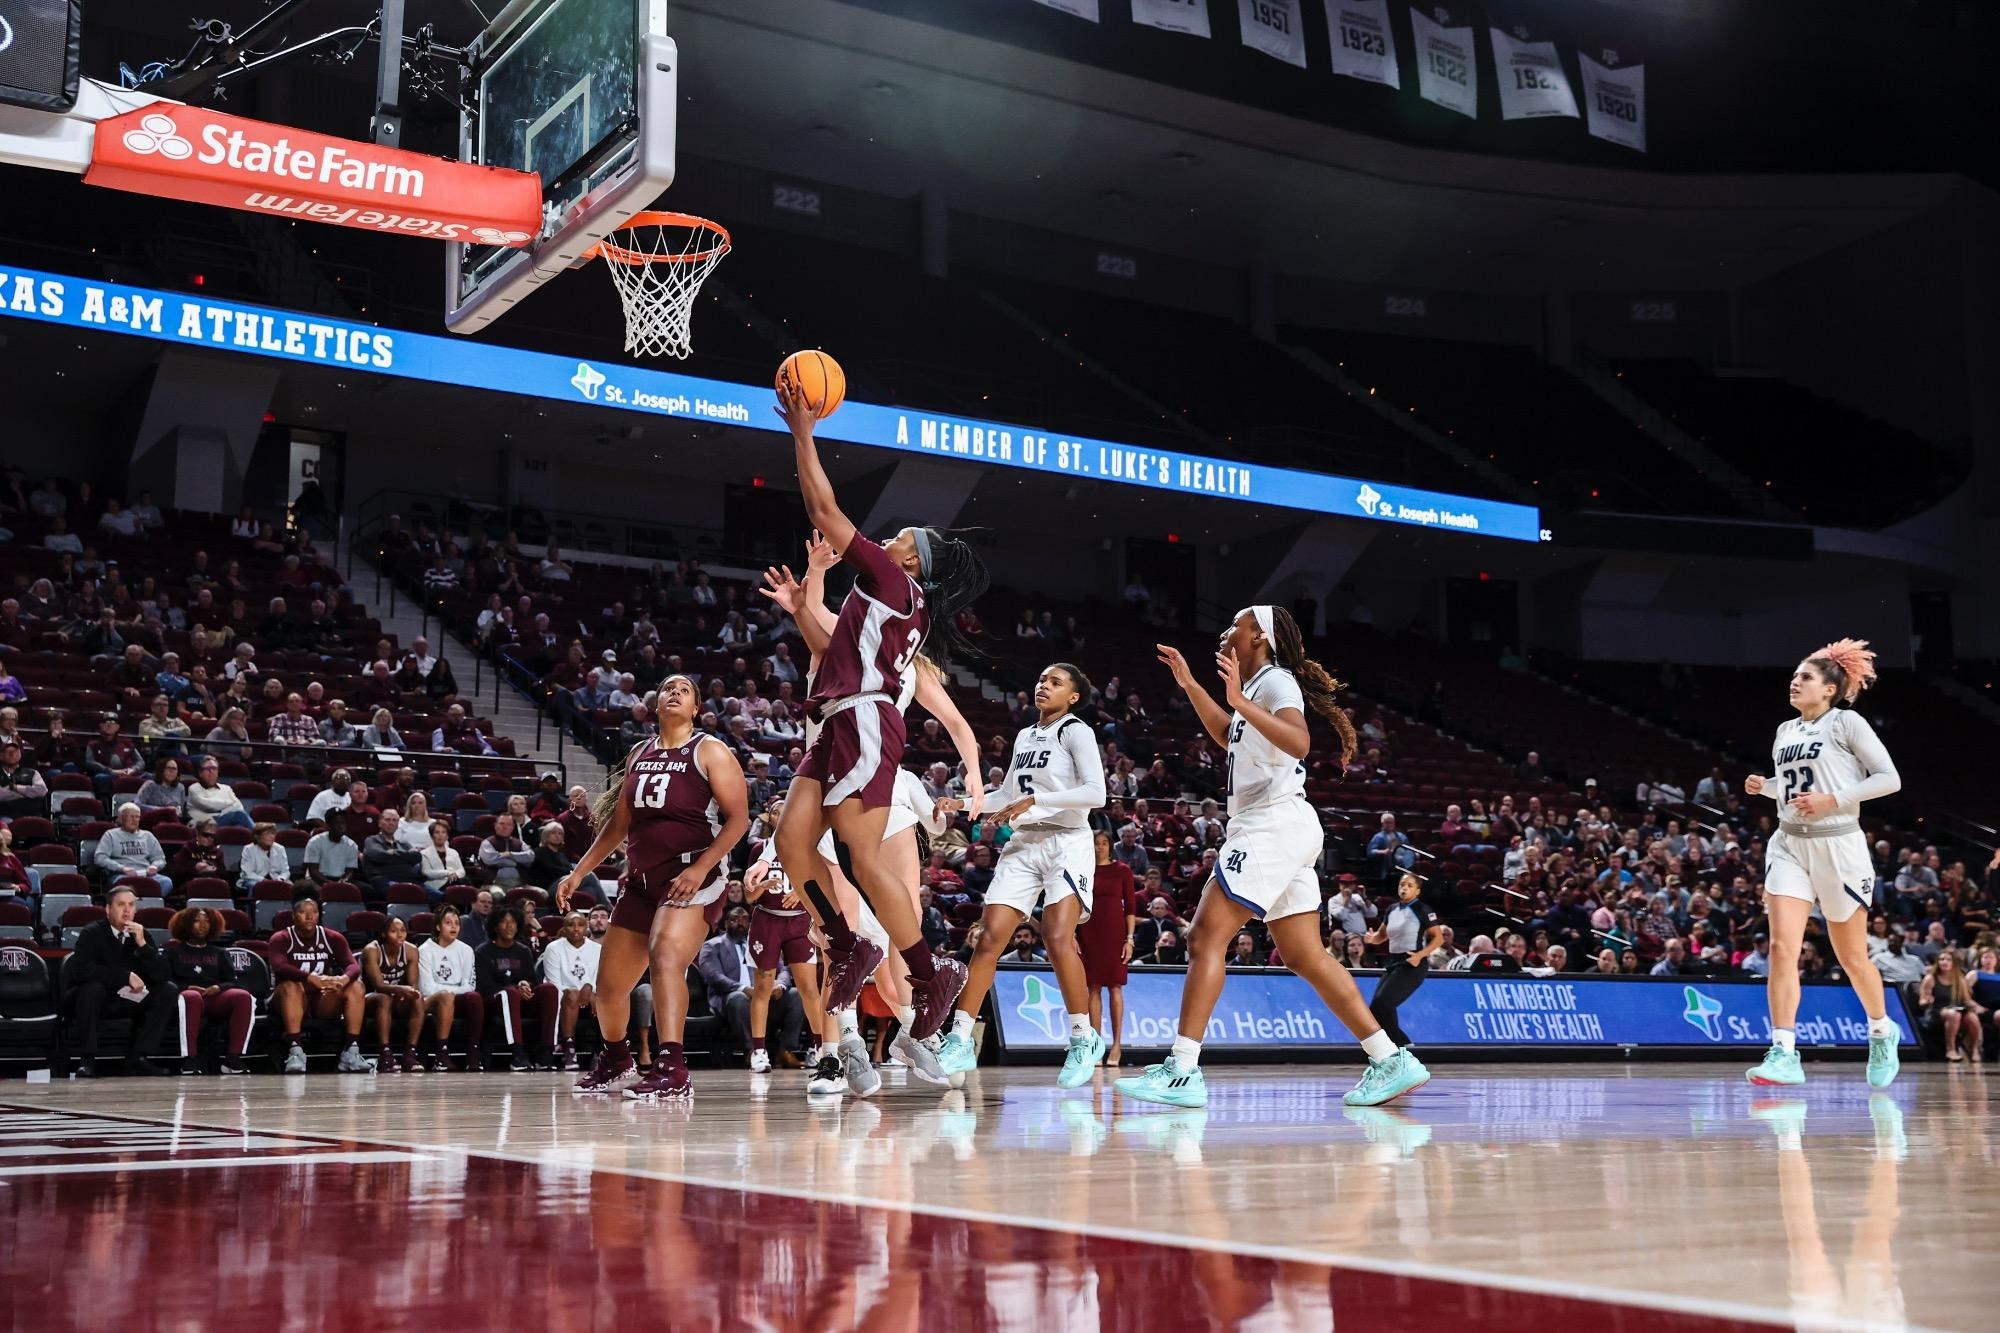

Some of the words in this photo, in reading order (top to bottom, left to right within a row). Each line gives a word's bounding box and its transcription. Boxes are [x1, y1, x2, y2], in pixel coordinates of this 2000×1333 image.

[1252, 2, 1290, 35] 1951
[1340, 25, 1386, 56] 1923
[1427, 51, 1467, 86] 1922
[1513, 68, 1559, 90] 192
[197, 123, 314, 180] State
[318, 146, 425, 198] Farm
[773, 187, 820, 214] 222
[81, 286, 163, 333] A&M
[178, 303, 393, 368] ATHLETICS
[605, 384, 628, 404] St.
[632, 388, 690, 415] Joseph
[695, 399, 749, 422] Health
[897, 415, 909, 445] A
[921, 418, 1012, 461] MEMBER
[1023, 434, 1048, 466] OF
[1058, 440, 1089, 472] ST.
[1100, 446, 1170, 485] LUKE'S
[1179, 459, 1251, 497] HEALTH
[1379, 501, 1396, 517] St.
[1397, 504, 1439, 525] Joseph
[1440, 510, 1479, 530] Health
[893, 627, 921, 673] 3
[635, 761, 665, 772] TEXAS
[665, 761, 687, 773] A&M
[633, 773, 671, 809] 13
[1473, 982, 1488, 1010] A
[1485, 983, 1559, 1011] MEMBER
[1556, 984, 1577, 1011] OF
[1233, 1010, 1327, 1039] Health
[1463, 1012, 1492, 1040] ST.
[1489, 1012, 1547, 1040] LUKE'S
[1545, 1013, 1605, 1041] HEALTH
[1727, 1015, 1760, 1040] St.
